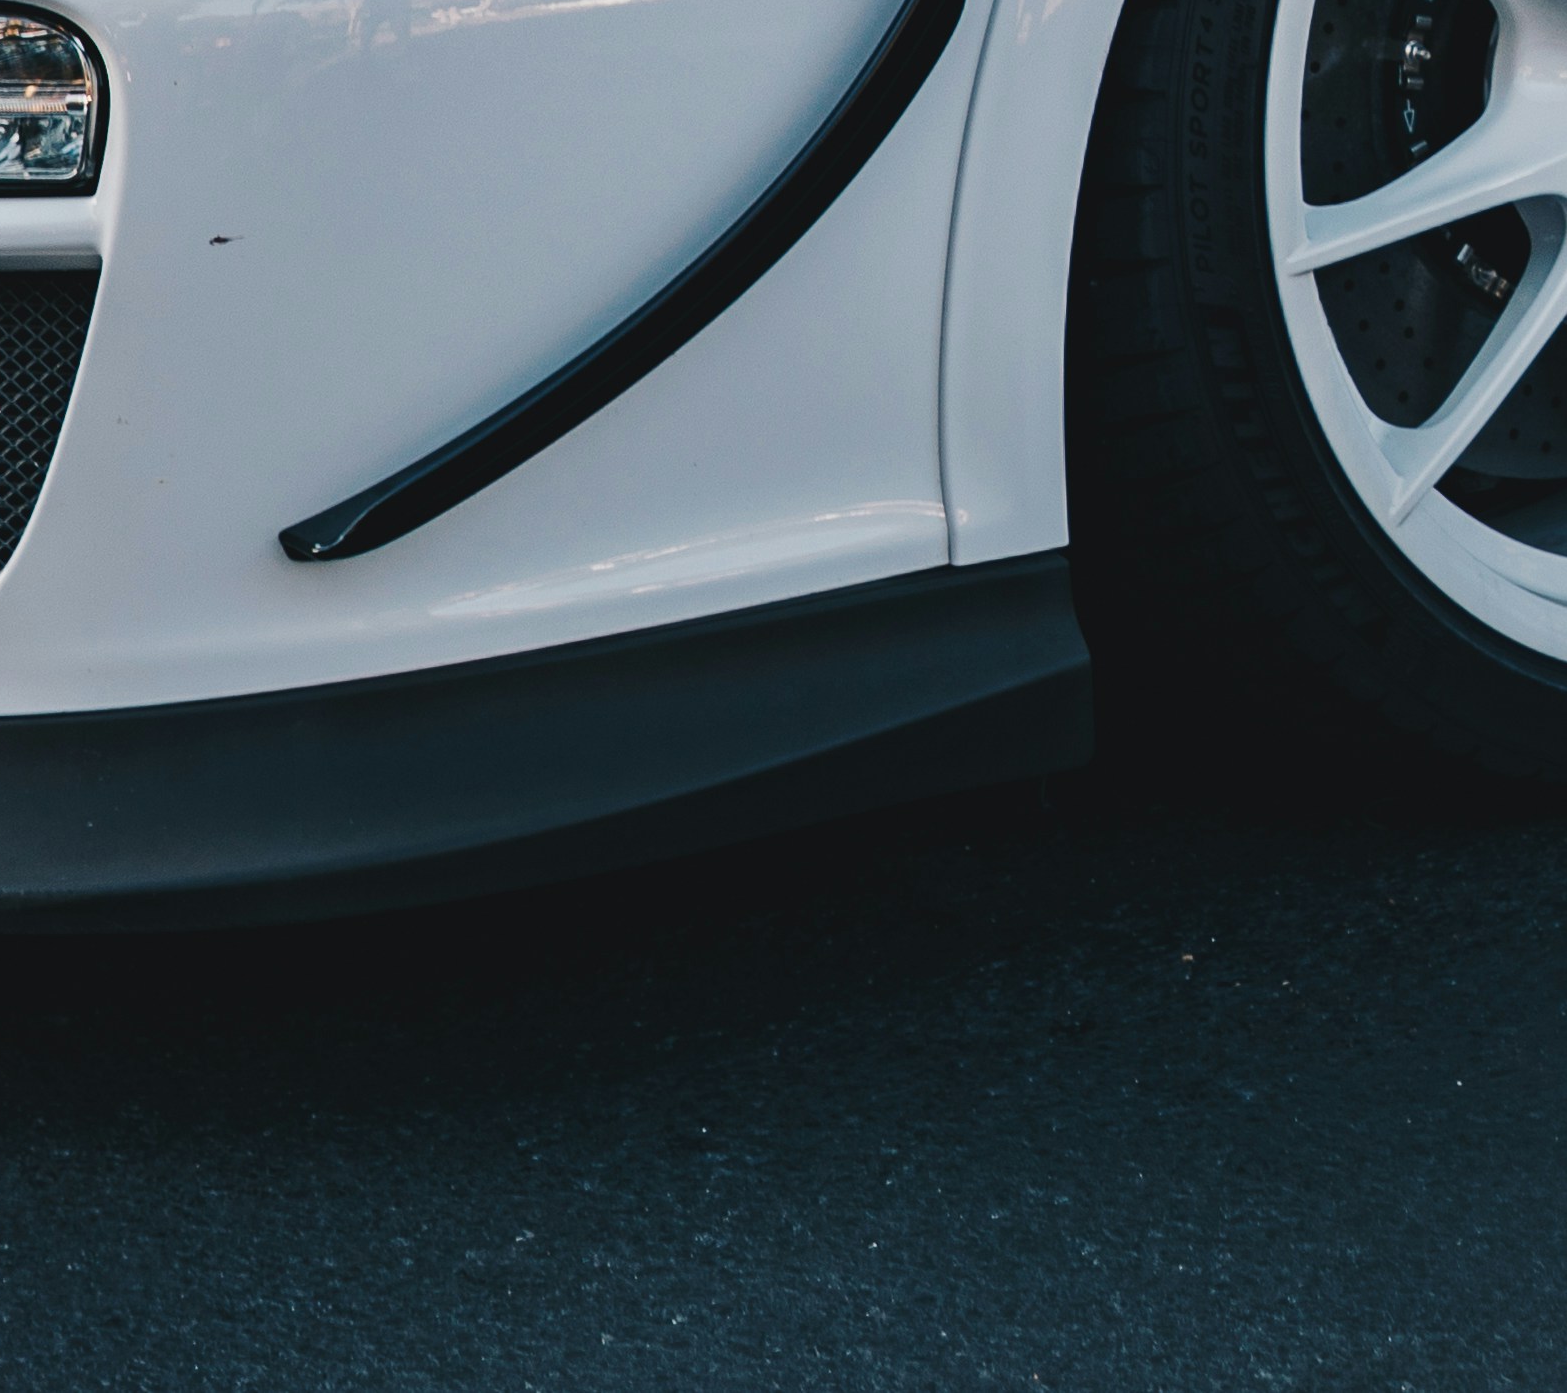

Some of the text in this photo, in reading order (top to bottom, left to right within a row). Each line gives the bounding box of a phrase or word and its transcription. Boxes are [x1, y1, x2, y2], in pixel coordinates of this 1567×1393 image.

[1200, 17, 1213, 32] 4
[1189, 36, 1213, 159] SPORT
[1190, 174, 1218, 274] PILOT
[1208, 326, 1384, 628] MICHELIN
